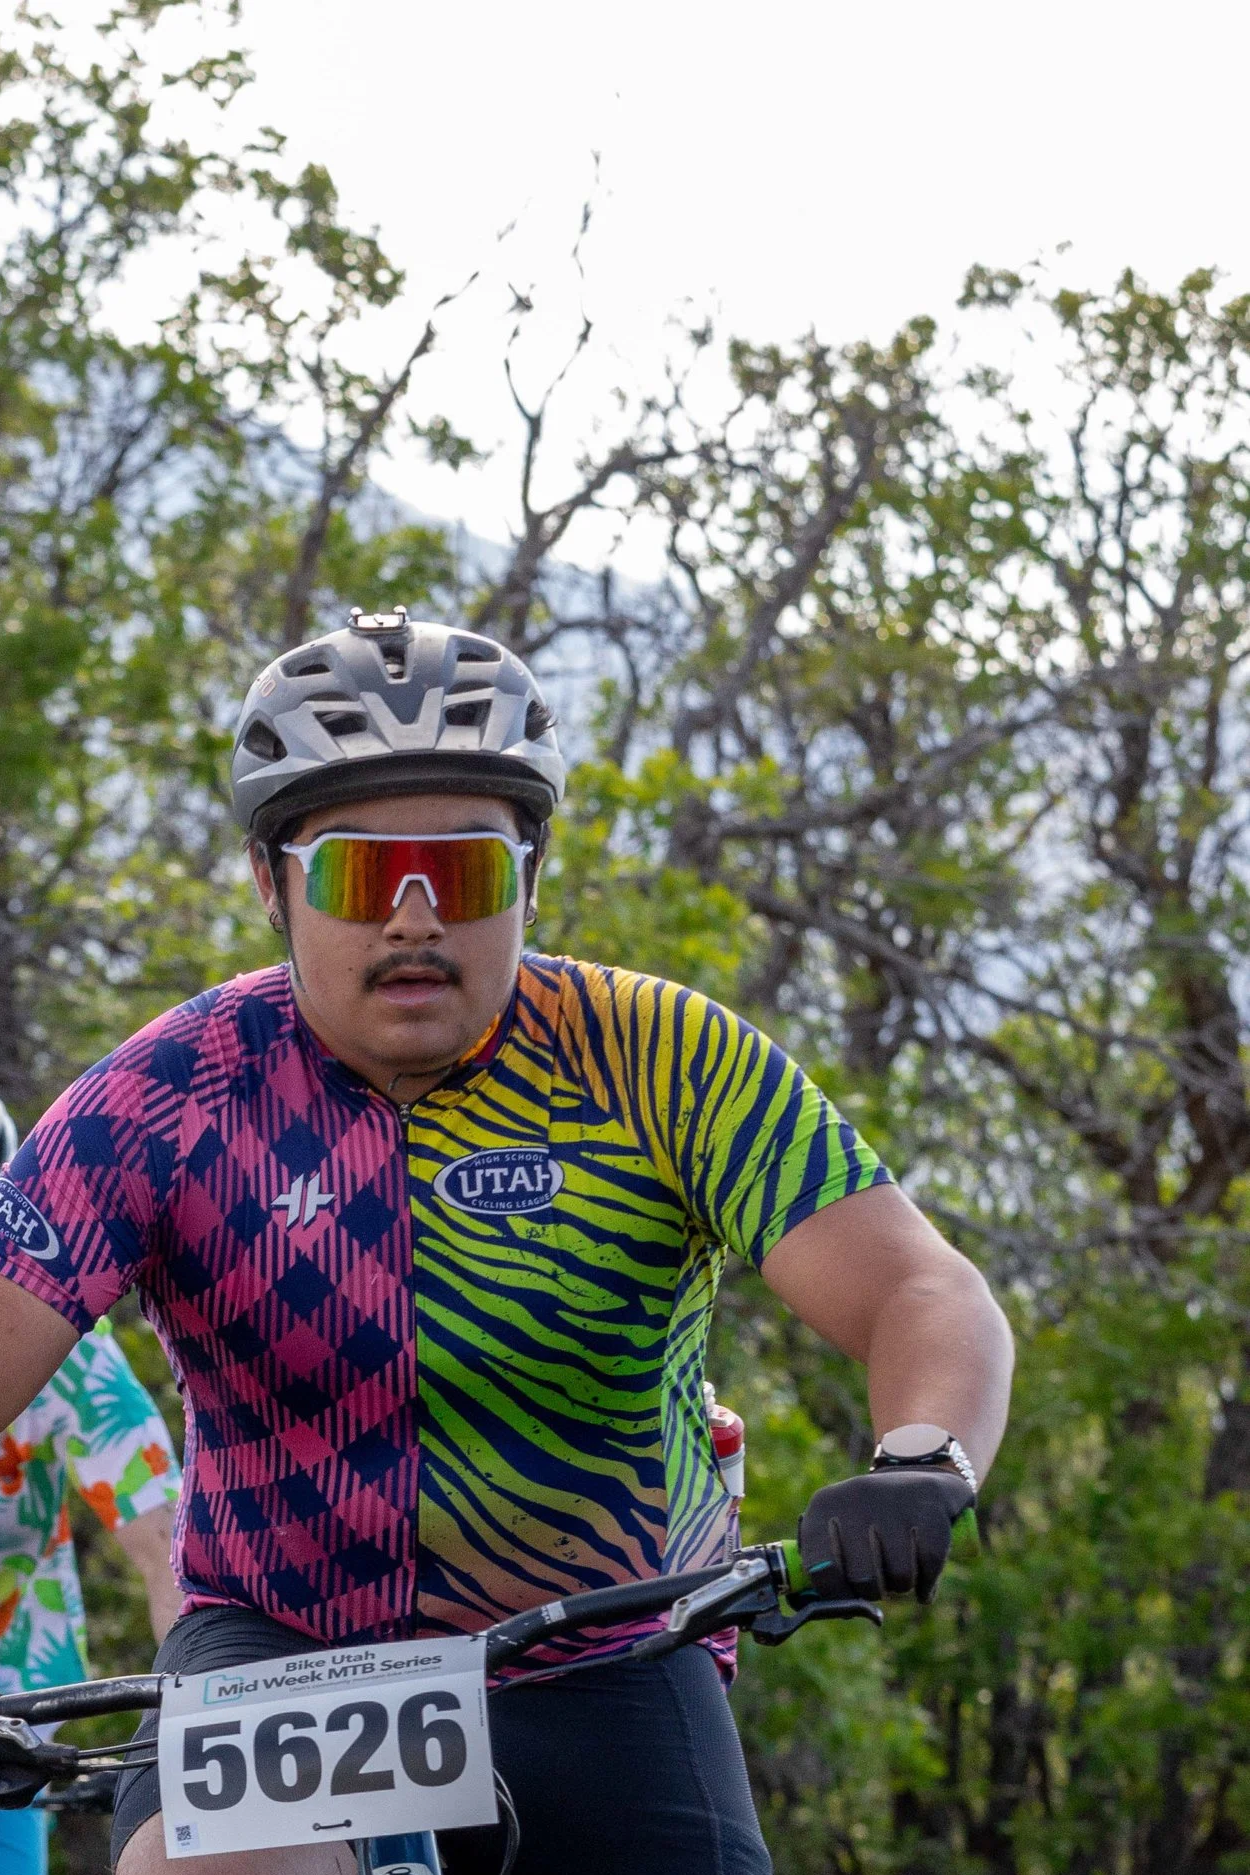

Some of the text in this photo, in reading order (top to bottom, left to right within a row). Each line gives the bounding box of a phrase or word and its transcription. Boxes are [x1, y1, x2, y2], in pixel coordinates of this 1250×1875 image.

[474, 1153, 544, 1167] HIGH SCHOOL
[458, 1164, 550, 1199] UTAH
[6, 1186, 31, 1213] SCHOOL
[471, 1193, 550, 1210] CYCLING LEAGUE
[285, 1650, 376, 1673] Bike Utah
[218, 1654, 443, 1697] Mid Week MTB Series
[182, 1690, 468, 1811] 5626
